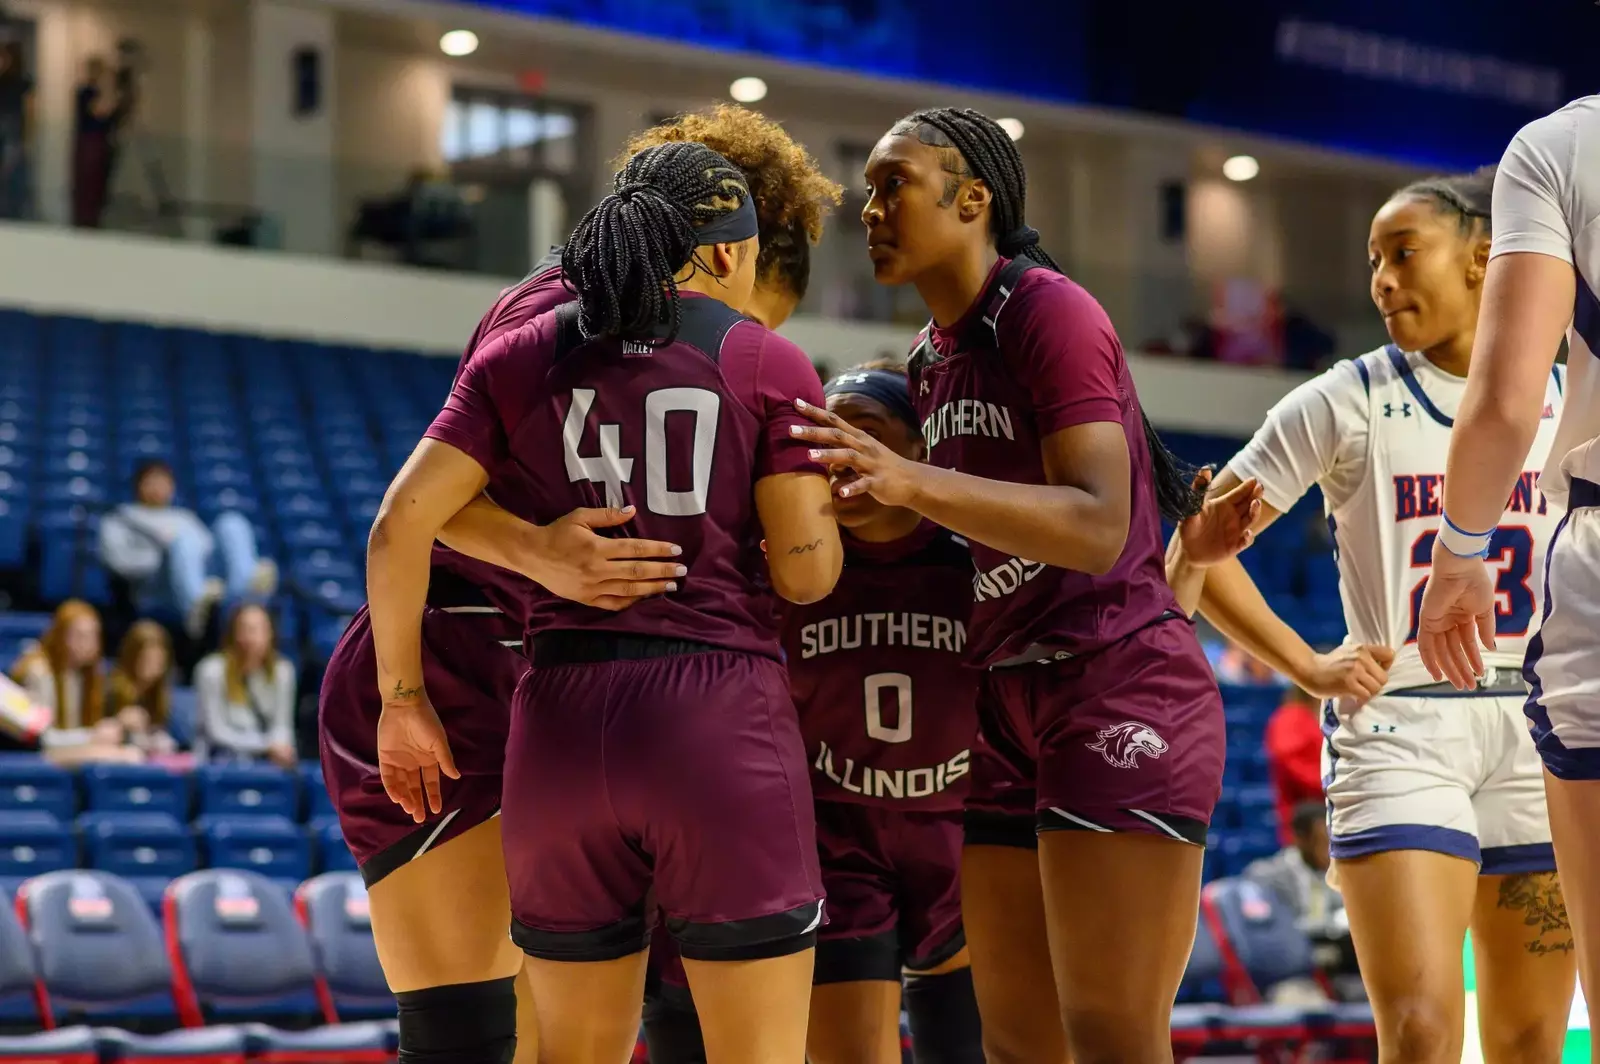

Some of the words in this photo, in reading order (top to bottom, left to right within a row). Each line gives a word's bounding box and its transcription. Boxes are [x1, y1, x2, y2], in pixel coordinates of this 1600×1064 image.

[563, 387, 720, 516] 40
[921, 399, 1015, 462] OUTHERN
[801, 612, 967, 659] SOUTHERN
[864, 672, 912, 743] 0
[815, 740, 970, 798] ILLINOIS
